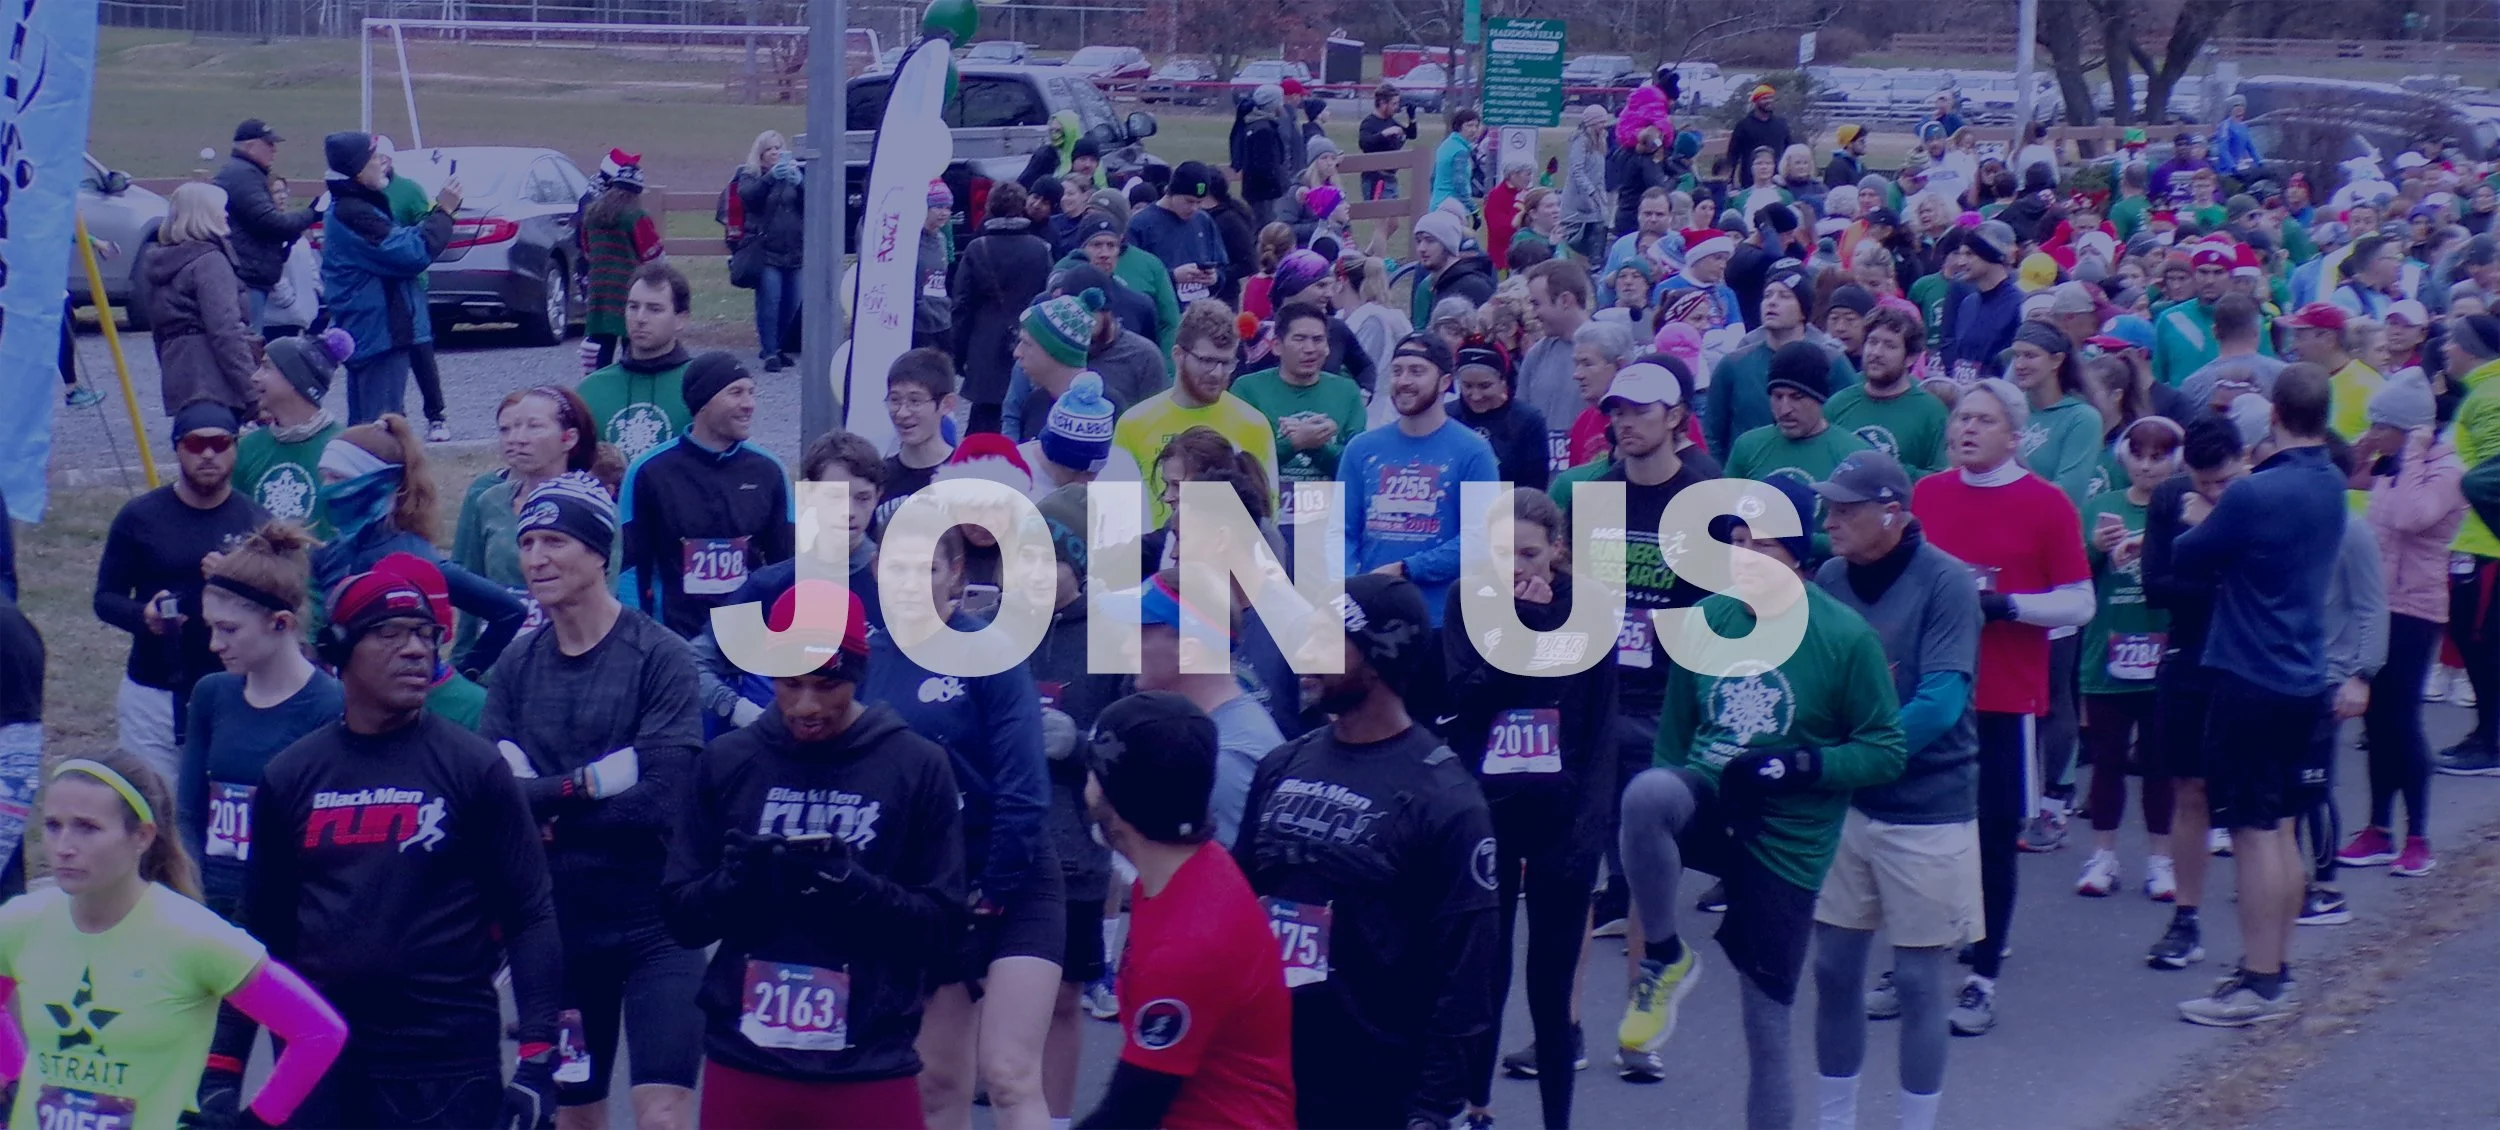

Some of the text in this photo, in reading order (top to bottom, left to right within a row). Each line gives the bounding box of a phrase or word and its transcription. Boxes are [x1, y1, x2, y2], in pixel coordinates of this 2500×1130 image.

[1281, 489, 1325, 512] 2103
[1385, 475, 1432, 500] 2255
[692, 550, 744, 578] 2198
[1492, 724, 1550, 755] 2011
[303, 803, 420, 849] run
[755, 981, 836, 1029] 2163
[37, 1052, 130, 1086] STRAIT
